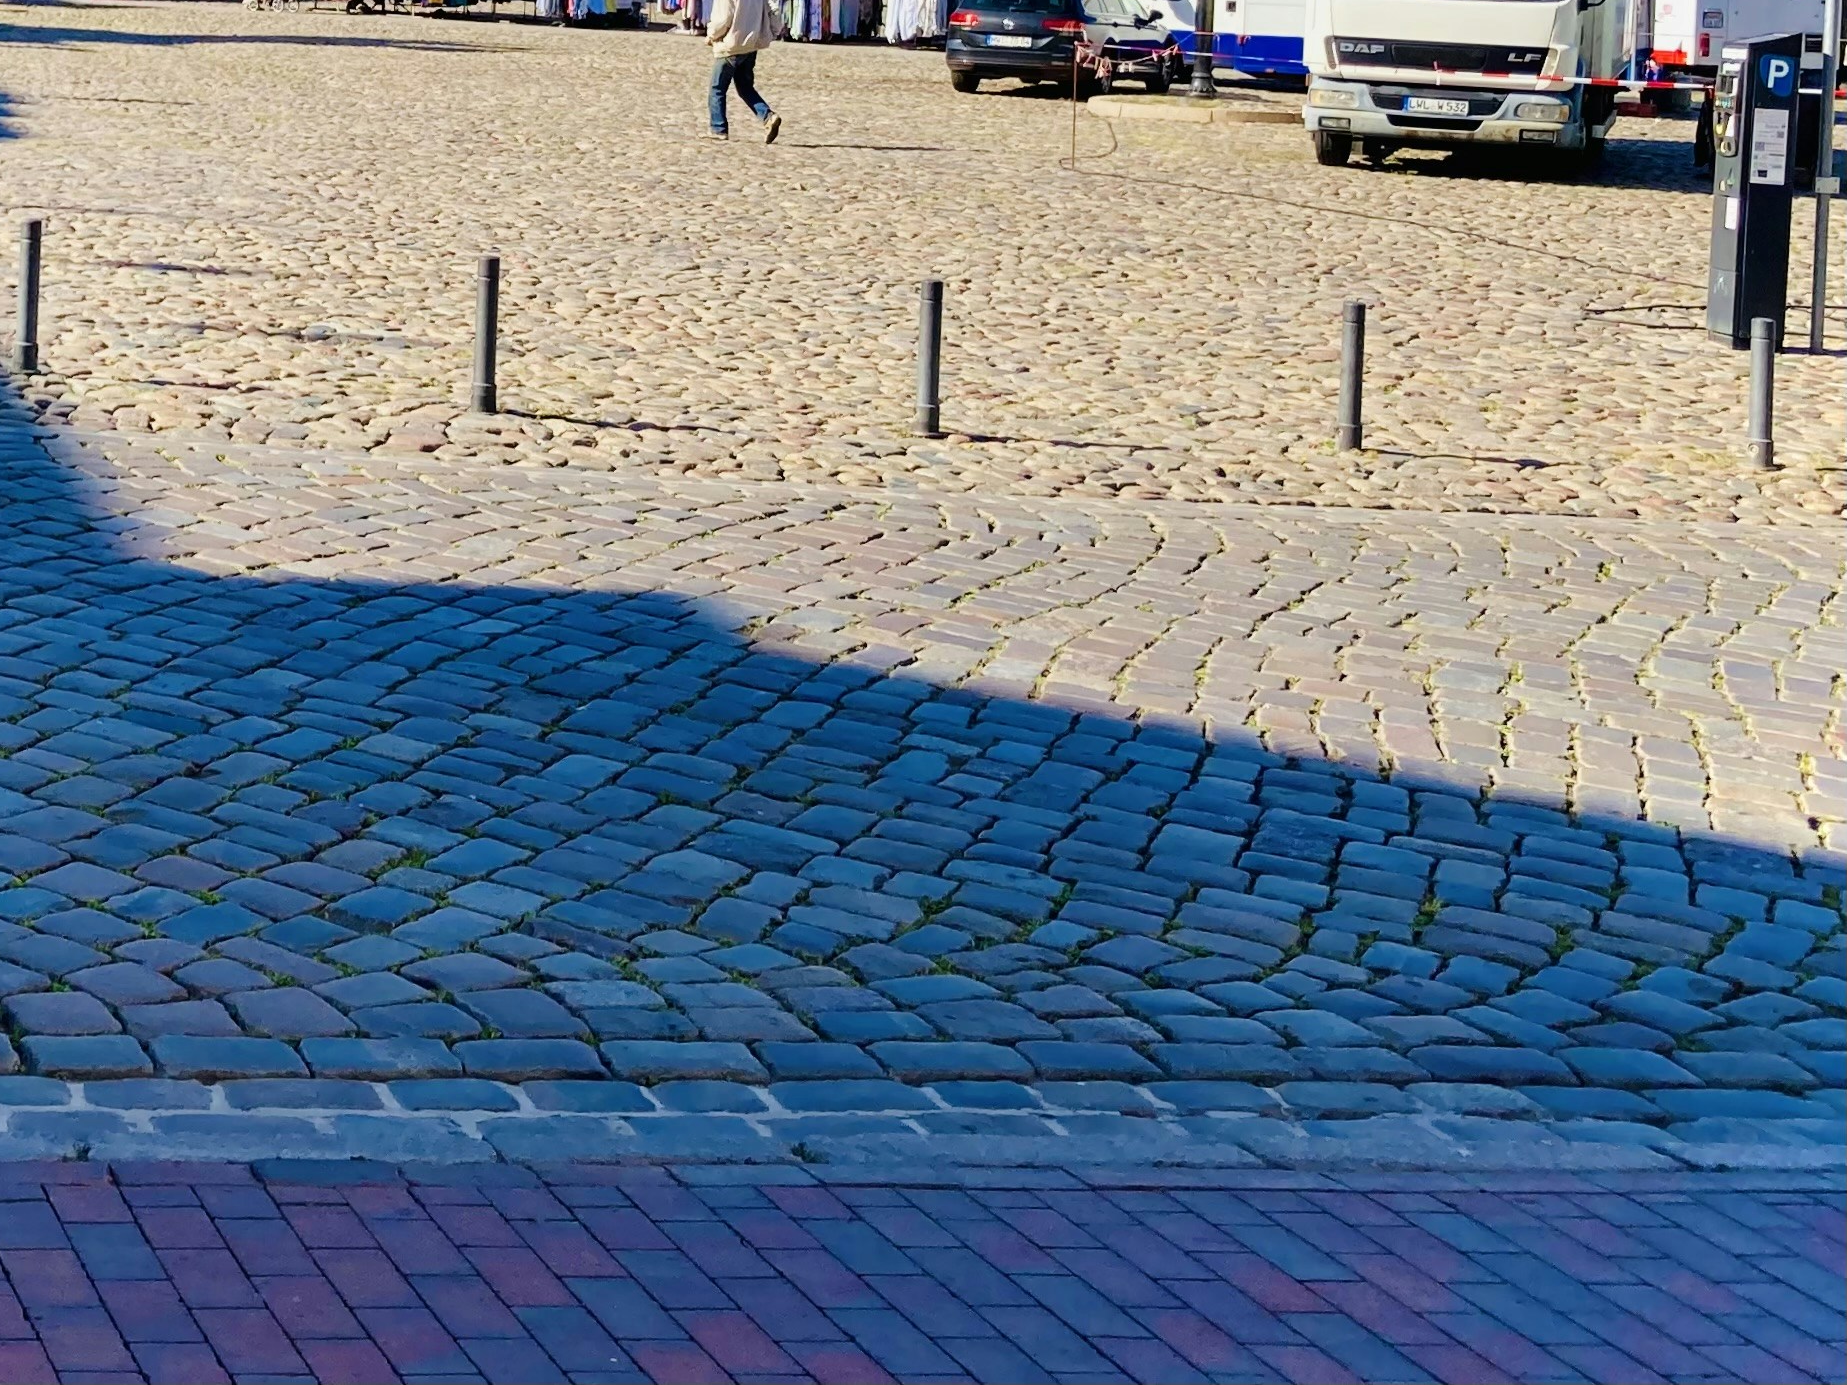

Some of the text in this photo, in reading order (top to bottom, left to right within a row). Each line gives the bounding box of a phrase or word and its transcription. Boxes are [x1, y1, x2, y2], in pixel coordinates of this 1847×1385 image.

[1339, 42, 1542, 63] DAF LF
[1767, 59, 1790, 89] P
[1409, 99, 1467, 113] LWL W 532
